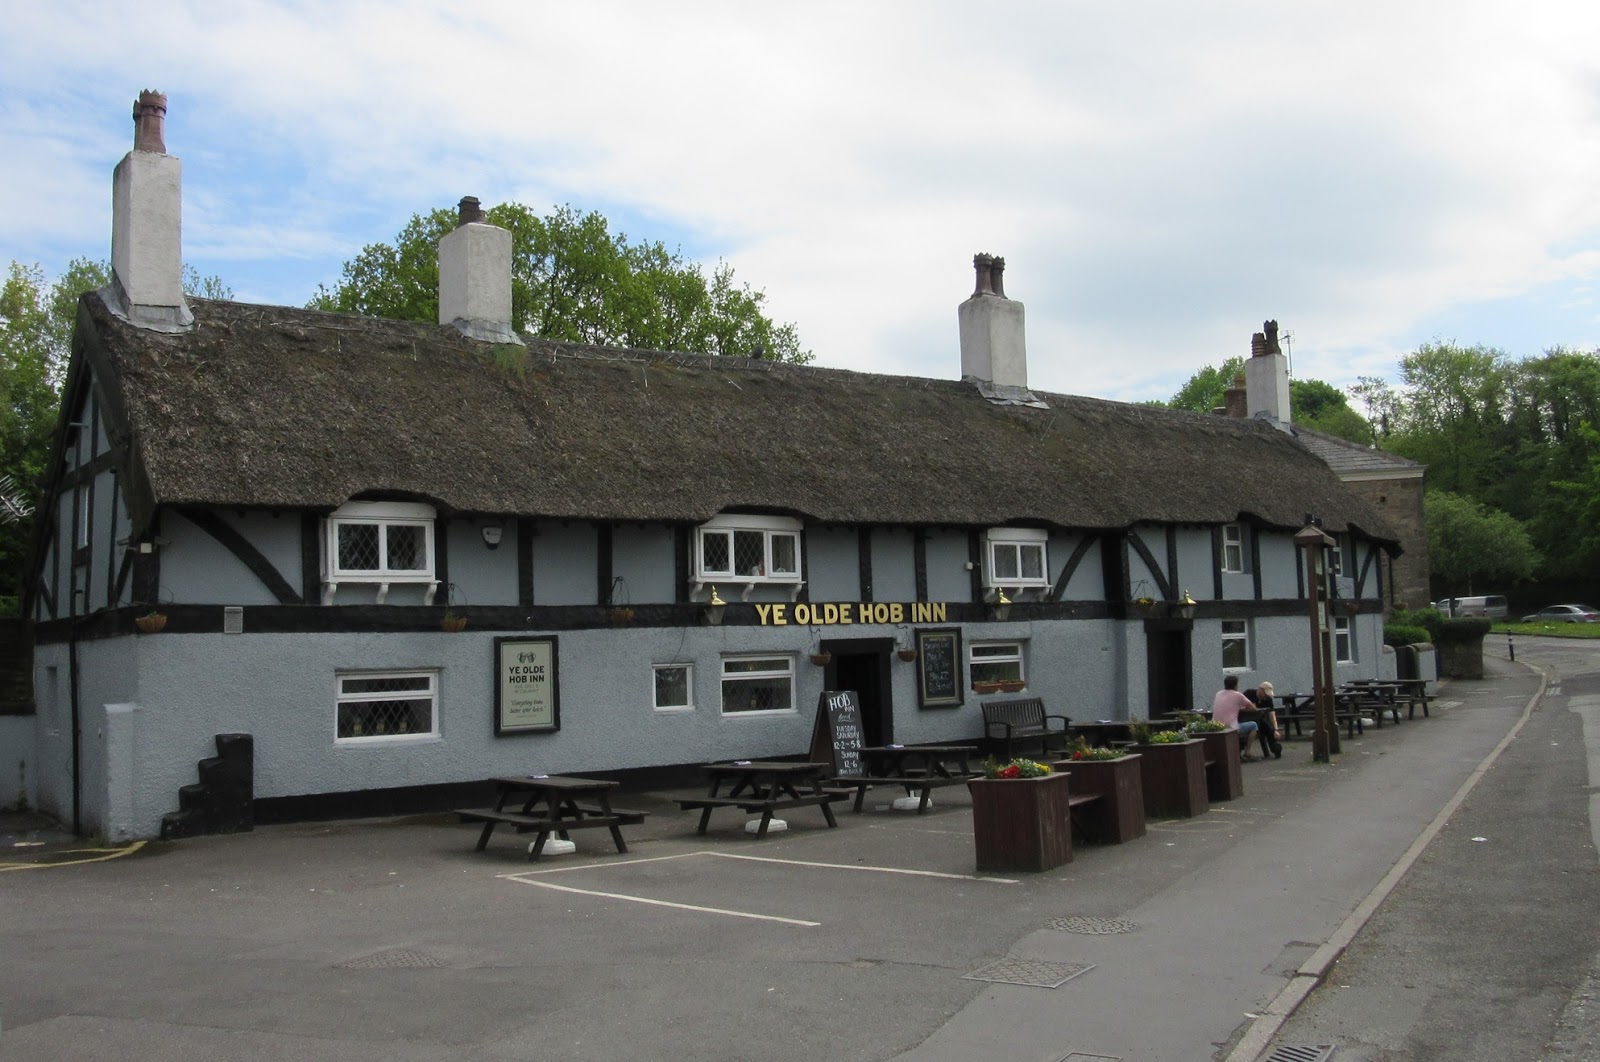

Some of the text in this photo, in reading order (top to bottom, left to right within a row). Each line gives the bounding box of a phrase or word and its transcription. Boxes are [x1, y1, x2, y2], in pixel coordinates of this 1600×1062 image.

[755, 602, 946, 625] YE OLDE HOB INN
[829, 693, 851, 711] HOB
[844, 760, 858, 768] 12-6
